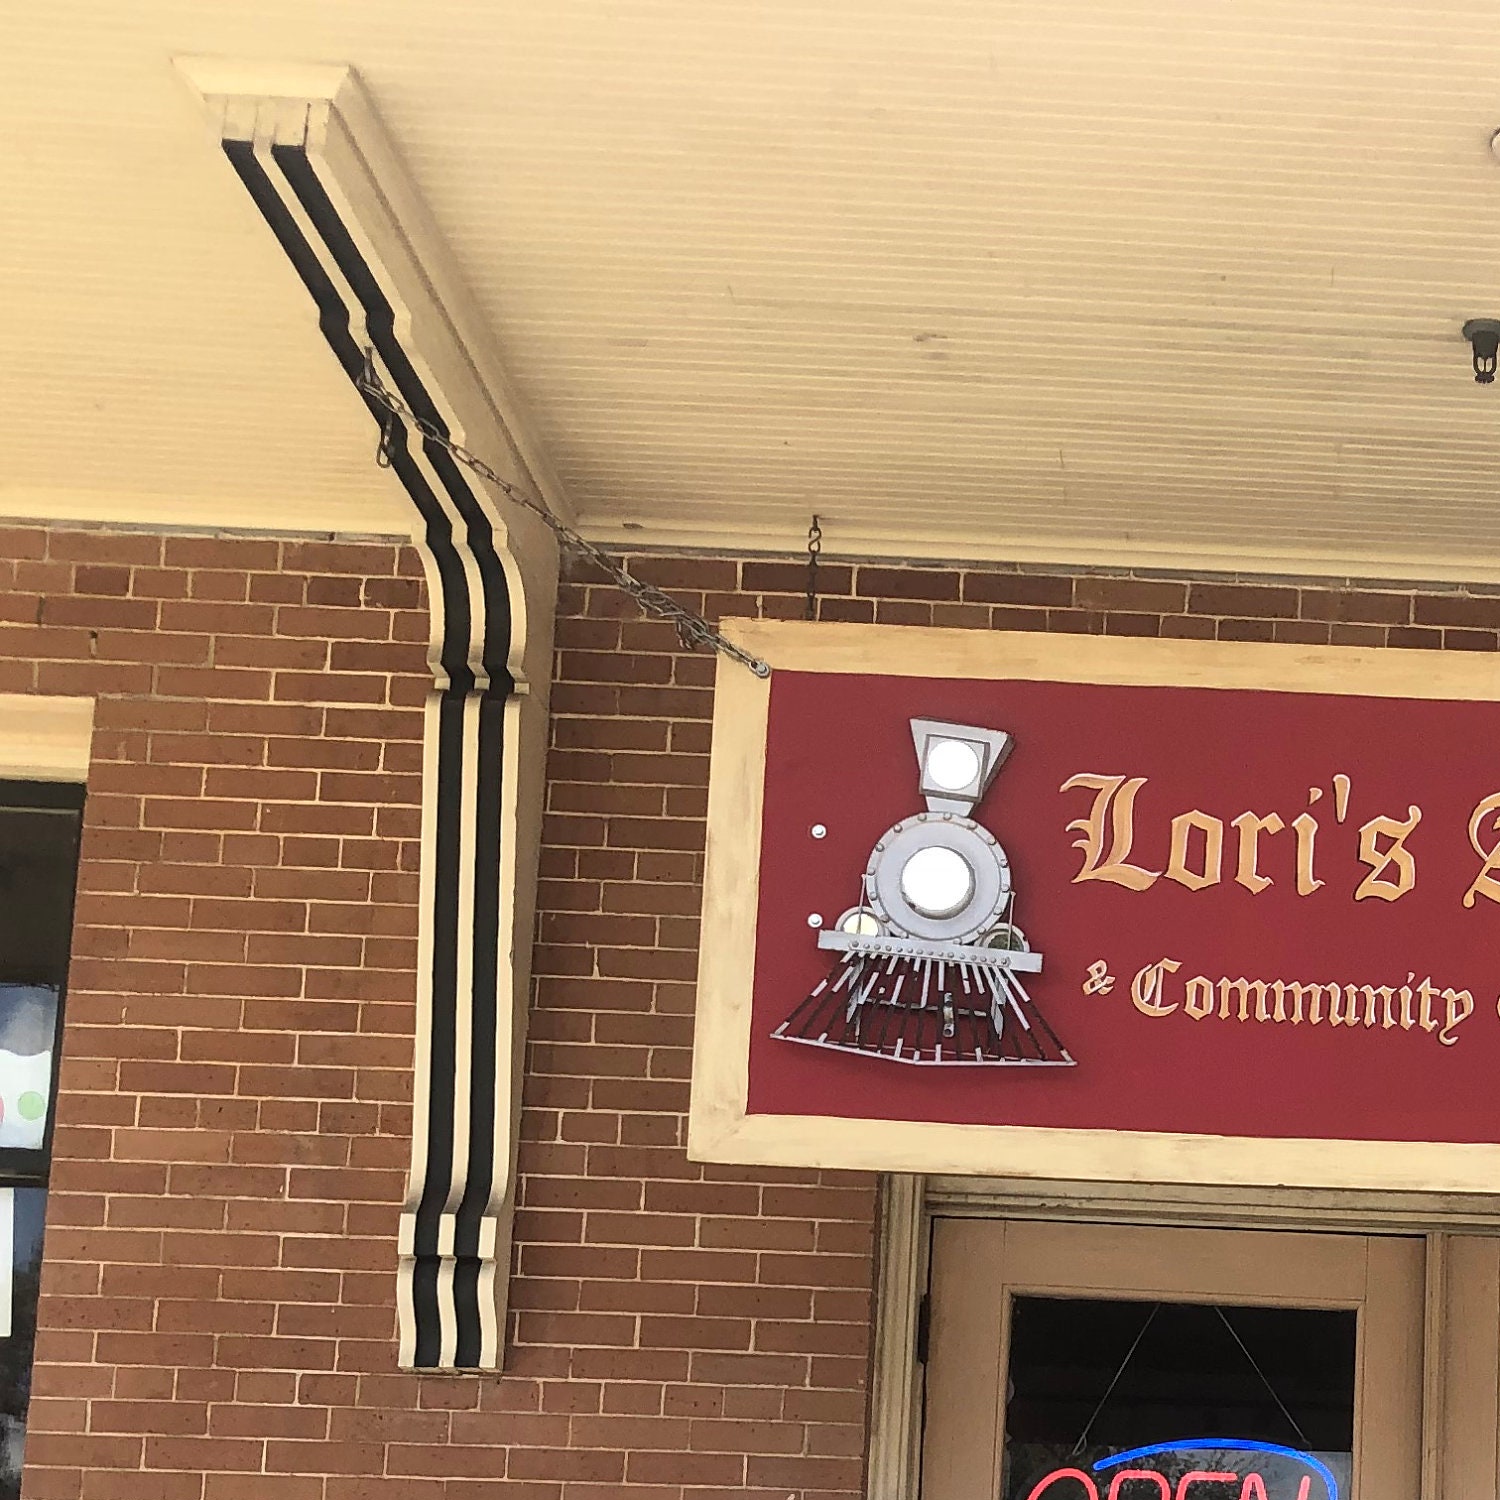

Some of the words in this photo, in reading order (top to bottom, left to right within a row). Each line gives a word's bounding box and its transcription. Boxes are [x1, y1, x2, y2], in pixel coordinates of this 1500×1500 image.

[1059, 773, 1423, 901] Lori's
[1082, 959, 1115, 996] &
[1131, 957, 1475, 1046] Community
